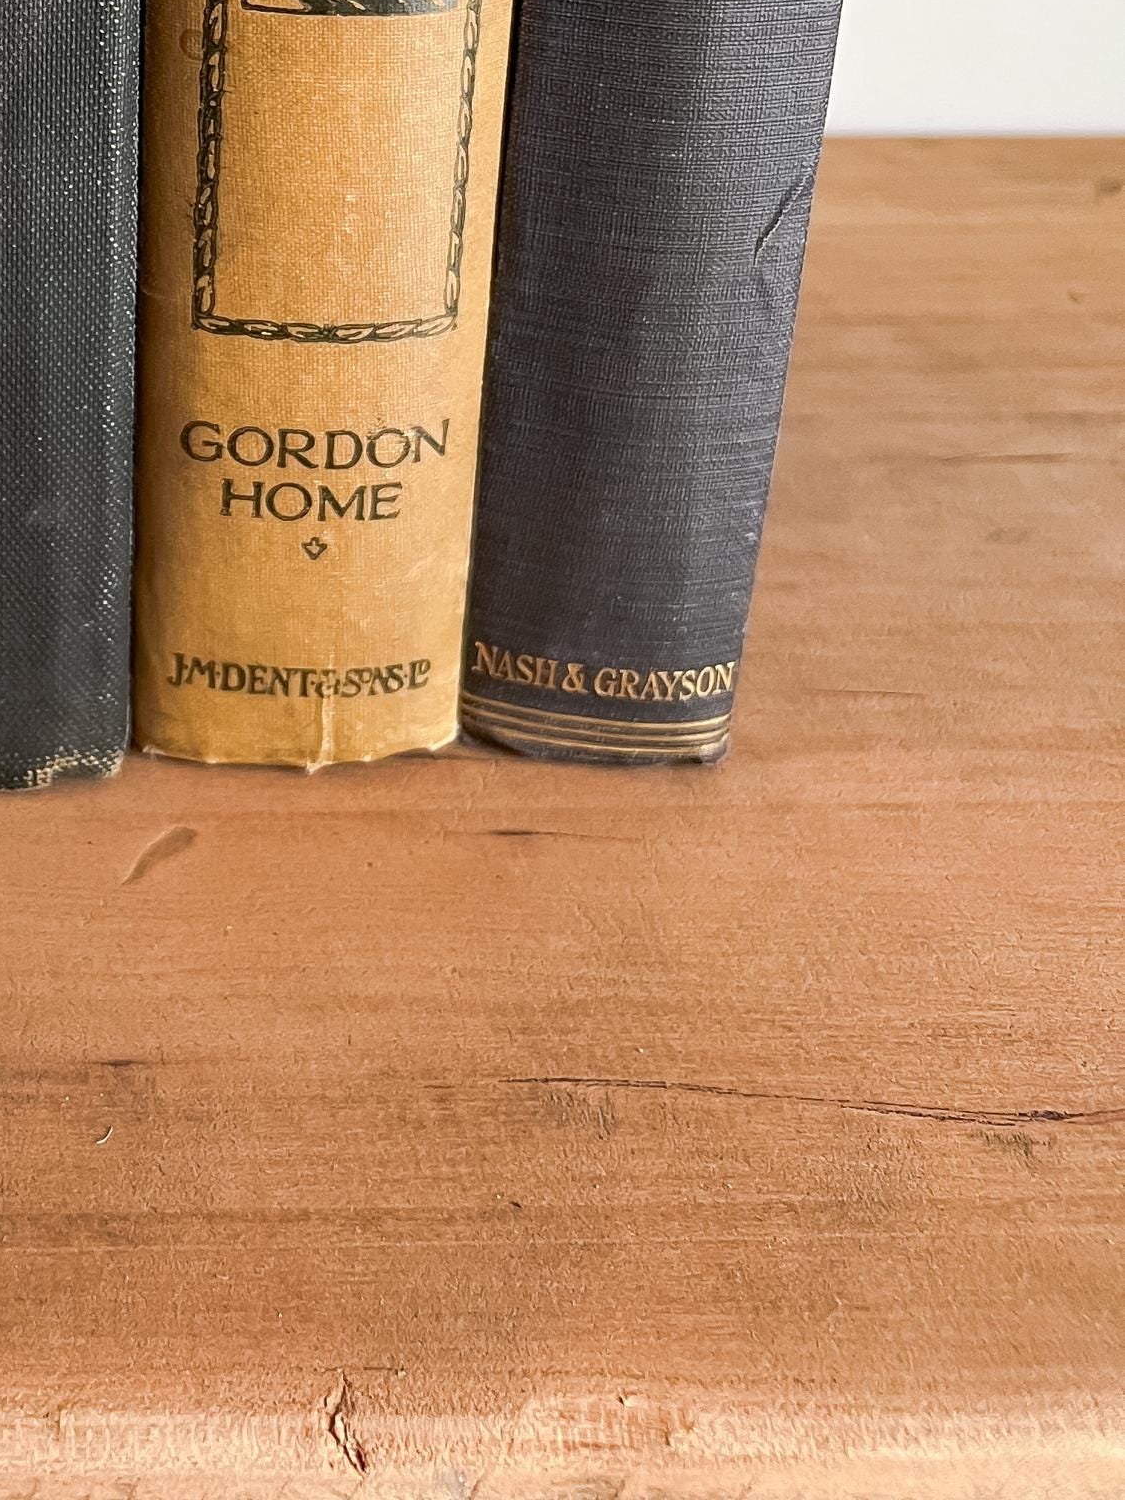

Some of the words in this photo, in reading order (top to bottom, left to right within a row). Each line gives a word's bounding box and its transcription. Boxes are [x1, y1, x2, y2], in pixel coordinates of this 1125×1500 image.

[180, 419, 450, 469] GORDON
[220, 478, 402, 522] HOME
[472, 641, 560, 690] NASH
[561, 662, 588, 695] &
[593, 661, 737, 702] GRAYSON
